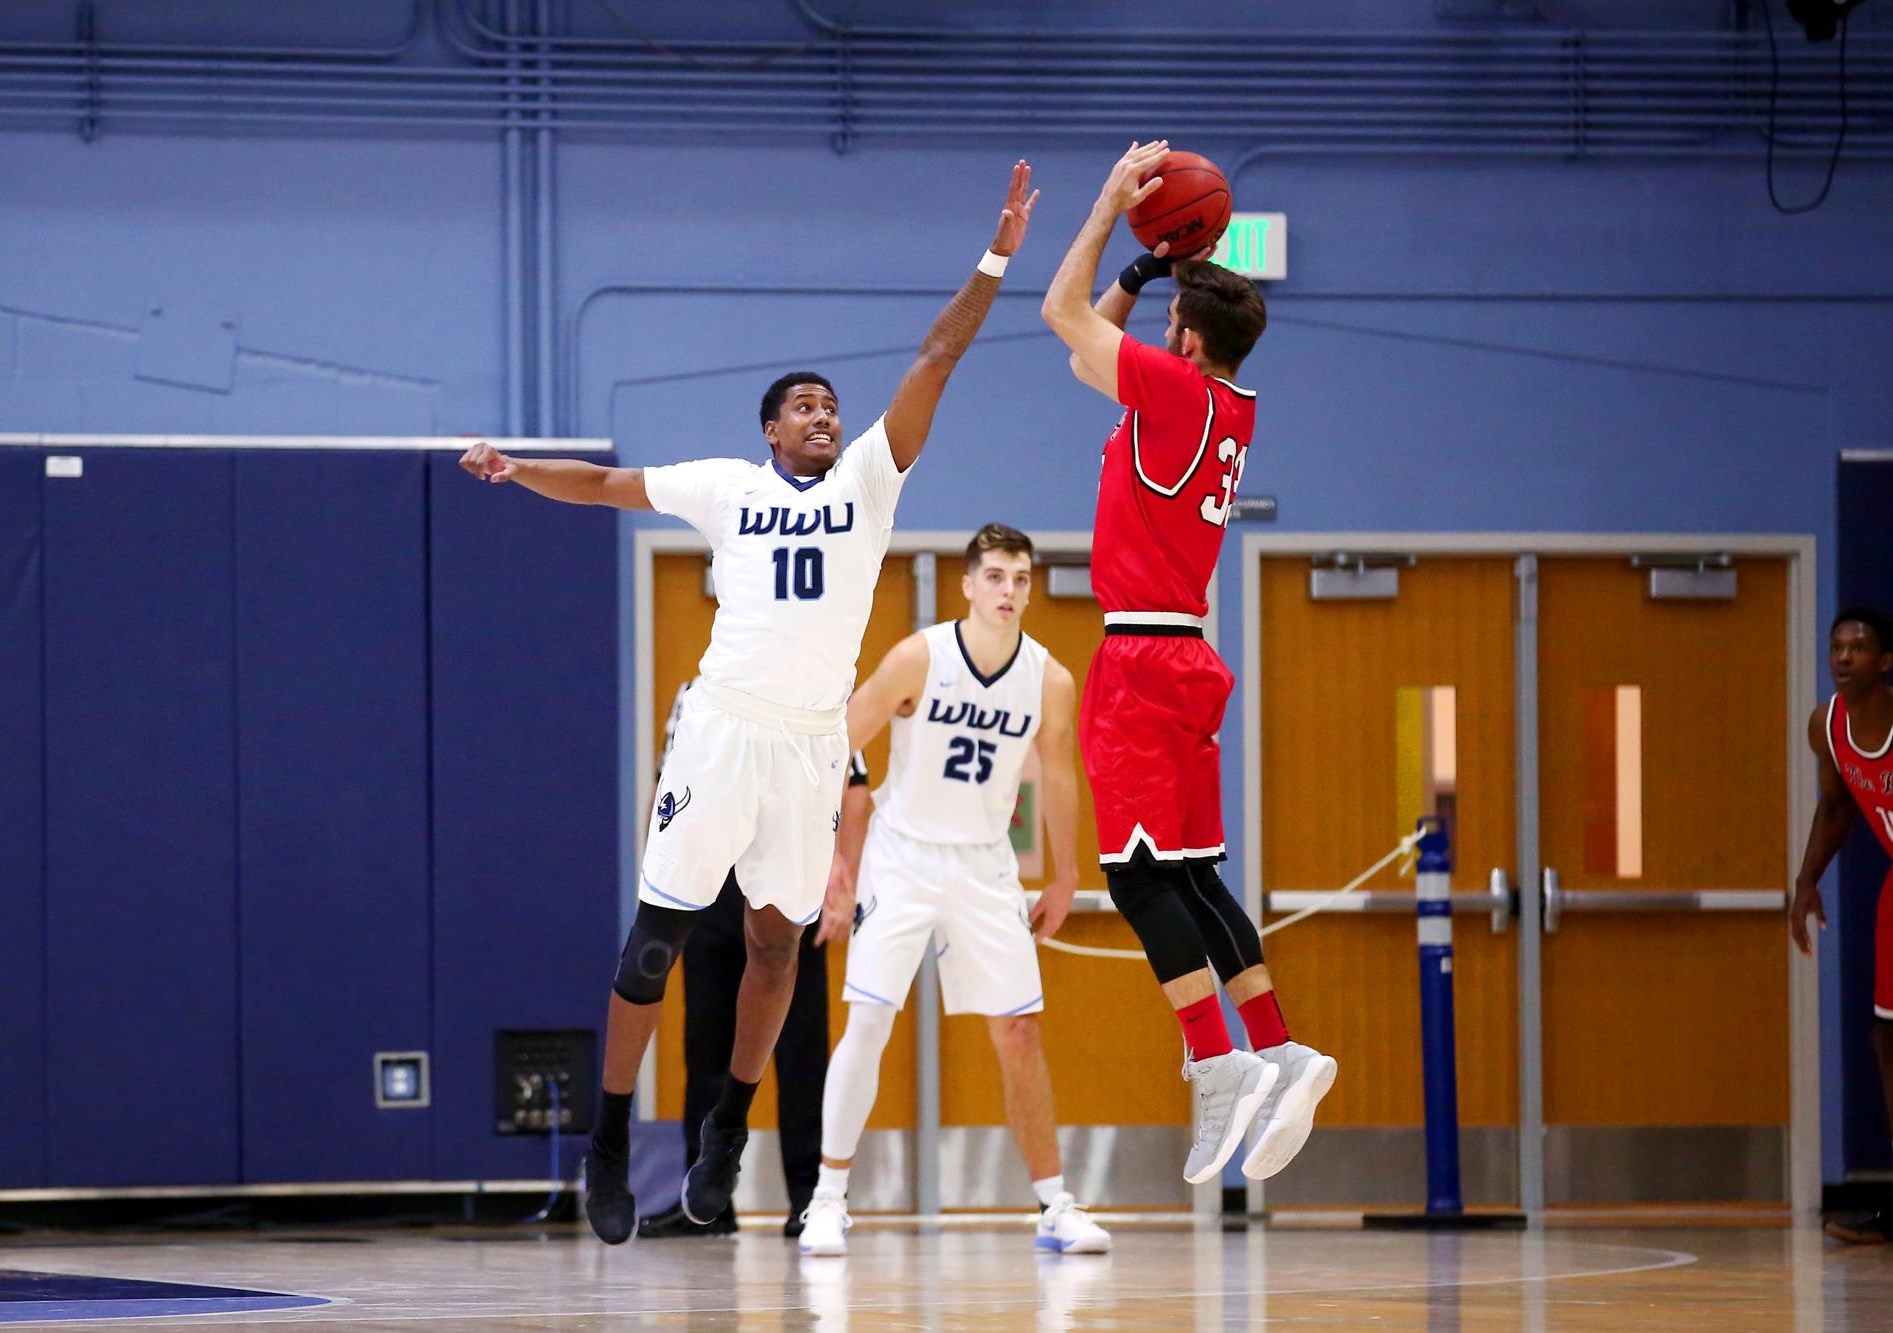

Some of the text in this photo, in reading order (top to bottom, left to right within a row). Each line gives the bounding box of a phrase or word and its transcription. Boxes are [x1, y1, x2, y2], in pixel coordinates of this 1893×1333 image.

[1213, 219, 1270, 272] XIT
[739, 502, 854, 536] WWU
[772, 546, 825, 601] 10
[928, 698, 1032, 738] WWU
[943, 736, 998, 785] 25
